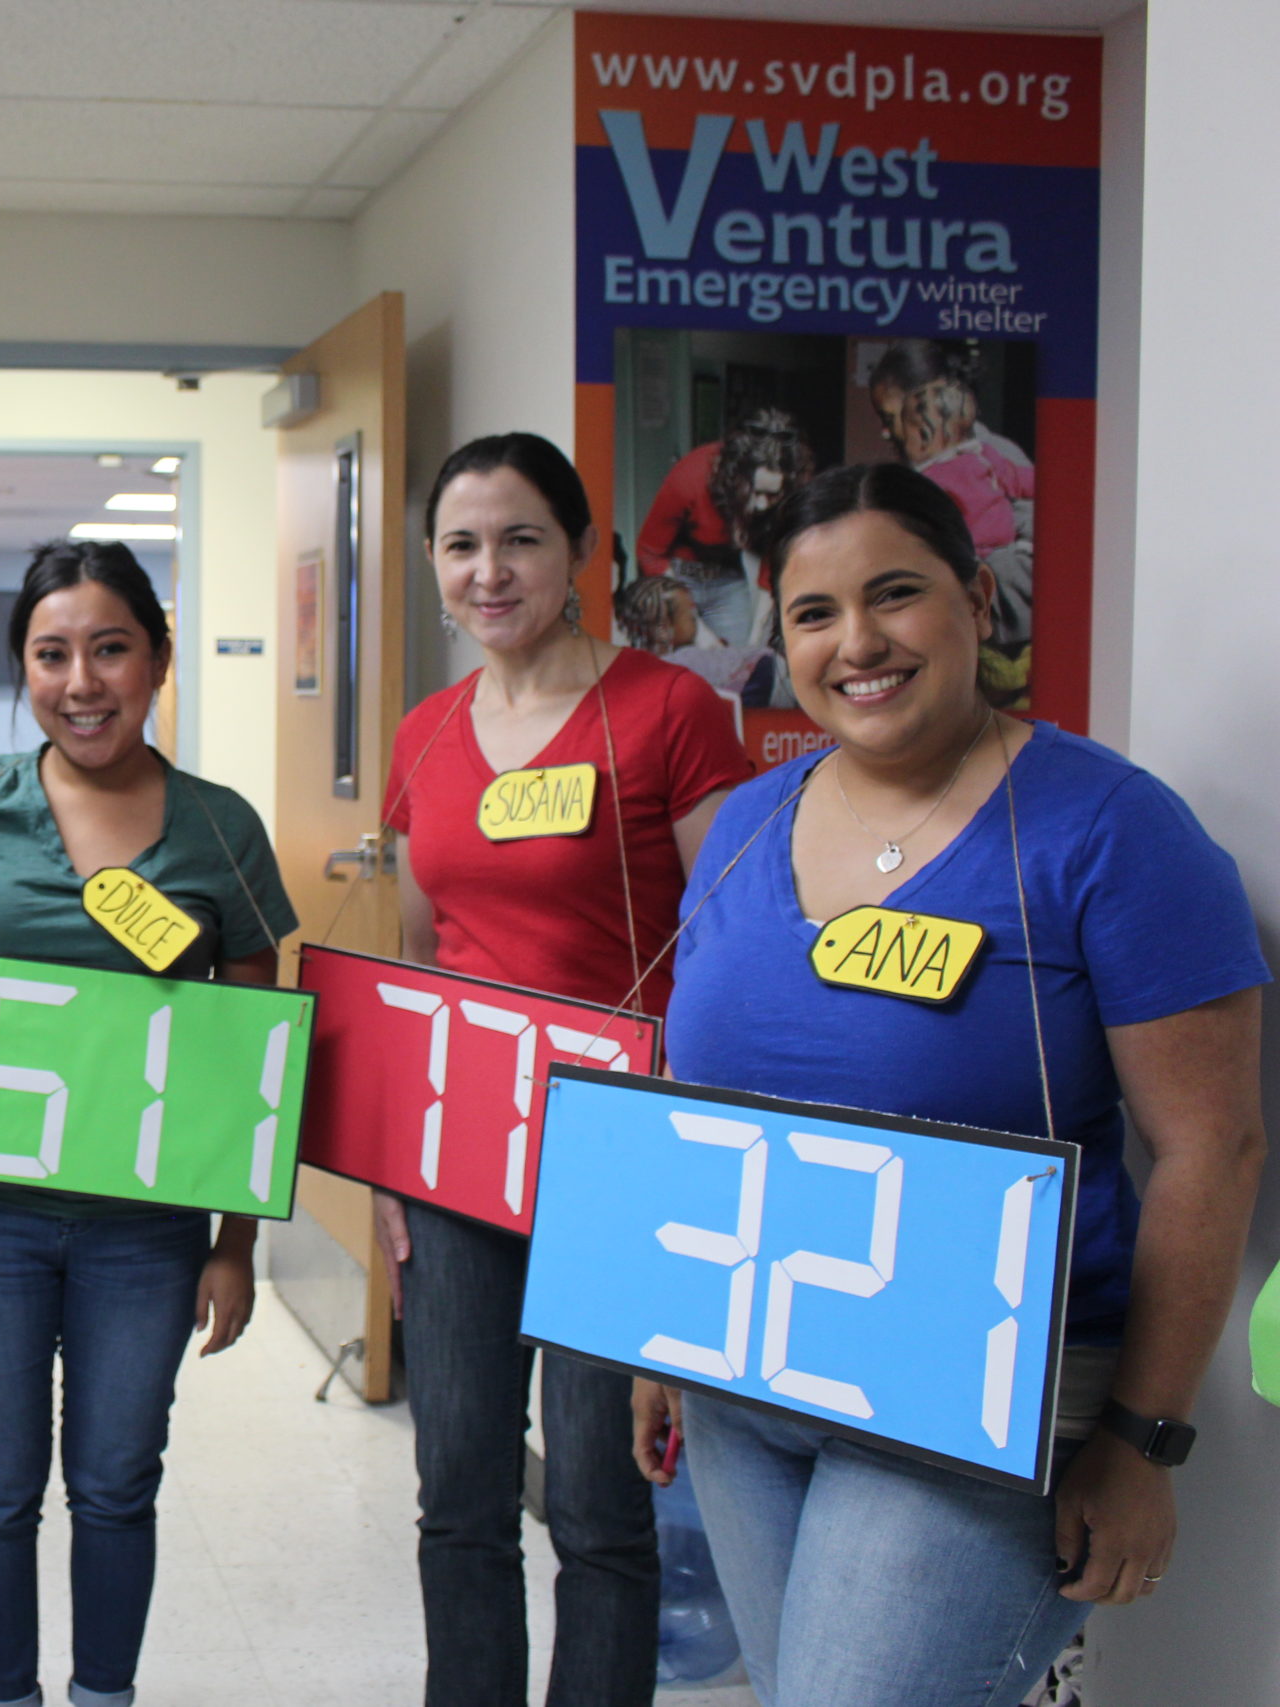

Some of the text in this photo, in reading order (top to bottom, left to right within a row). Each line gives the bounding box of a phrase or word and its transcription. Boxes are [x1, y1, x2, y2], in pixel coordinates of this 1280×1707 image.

[592, 51, 1072, 121] www.svdpla.org
[599, 109, 1018, 273] Ventura
[745, 118, 939, 199] West
[603, 256, 1024, 326] Emergency winter
[938, 302, 1048, 333] shelter
[489, 776, 585, 826] SUSANA
[97, 880, 187, 960] DULCE
[833, 918, 952, 992] ANA
[639, 1111, 1034, 1449] 321
